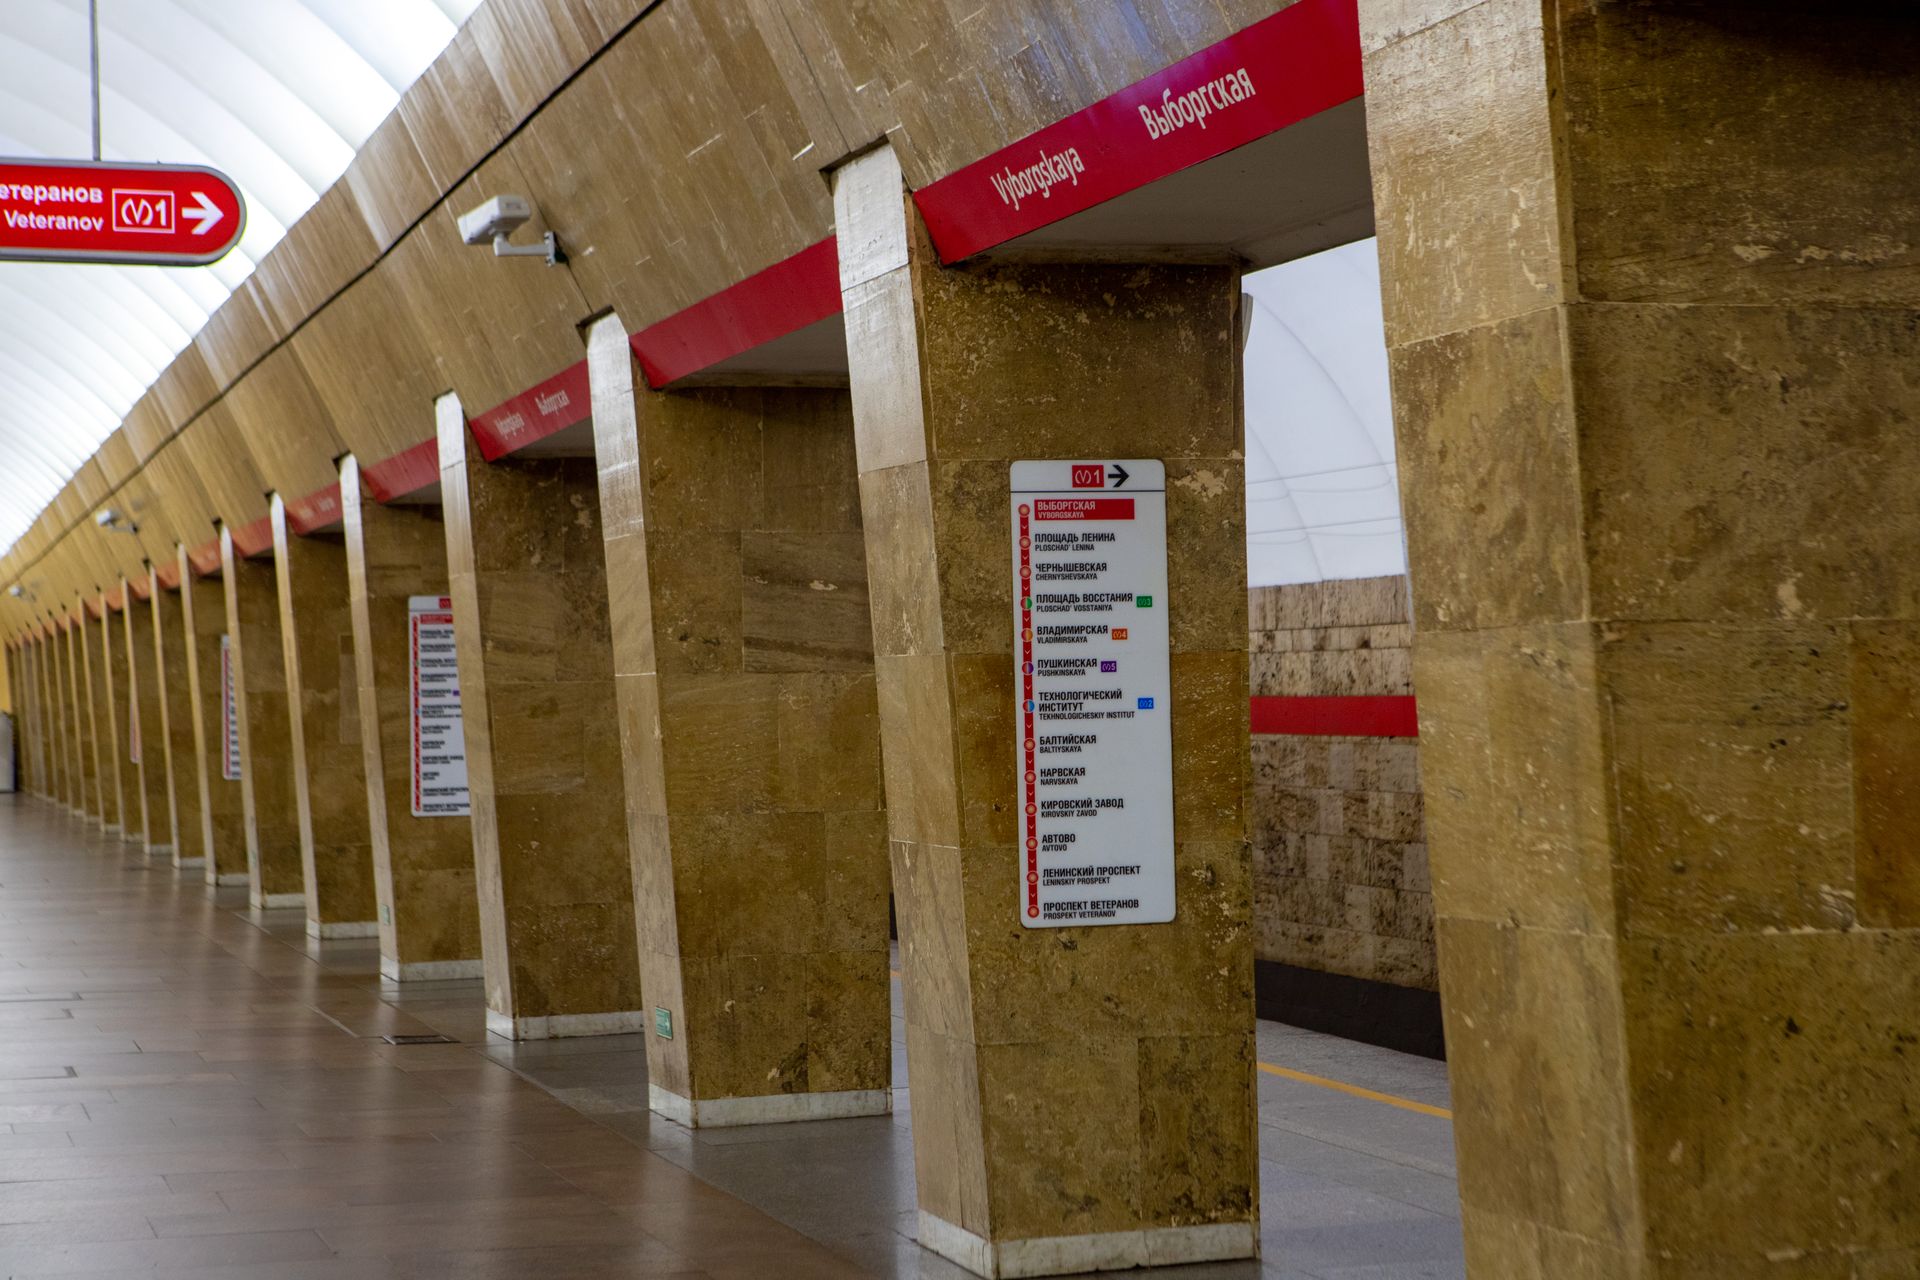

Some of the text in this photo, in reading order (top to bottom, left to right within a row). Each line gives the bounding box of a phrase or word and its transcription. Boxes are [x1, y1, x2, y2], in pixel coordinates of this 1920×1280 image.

[1138, 68, 1256, 140] Выборгская
[990, 147, 1085, 211] Vyborgskaya
[4, 209, 104, 231] Veteranov
[1038, 501, 1096, 510] ВЫБОРГСКАЯ
[1035, 533, 1115, 543] ПЛОЩАДЬ ЛЕНИНА
[1036, 563, 1107, 573] ЧЕРНЫШЕВСКАЯ
[1036, 573, 1097, 581] CHERNYSHEVSKAYA
[1036, 593, 1133, 604] ПЛОЩАДЬ ВОССТАНИЯ
[1075, 604, 1112, 612] VOSSTANIYA
[1037, 625, 1108, 636] ВЛАДИМИРСКАЯ
[1038, 659, 1097, 668] ПУШКИНСКАЯ
[1038, 669, 1085, 677] PUSHKINSKAYA
[1039, 689, 1122, 701] ТЕХНОЛОГИЧЕСКИЙ
[1039, 702, 1083, 712] ИНСТИТУТ
[1040, 711, 1134, 720] TEKHNOLOGICHESKIY INSTITUT
[1040, 734, 1096, 745] БАЛТИЙСКАЯ
[1041, 768, 1085, 777] НАРВСКАЯ
[1041, 778, 1078, 786] NARVSKAYA
[1041, 798, 1123, 809] КИРОВСКИЙ ЗАВОД
[1042, 809, 1097, 818] KIROVSKIY ZAVOD
[1042, 834, 1075, 844] АВТОВО
[1043, 866, 1141, 878] ЛЕНИНСКИЙ ПРОСПЕКТ
[1043, 877, 1110, 886] LENINSKIY PROSPEKT
[1044, 899, 1138, 911] ПРОСПЕКТ ВЕТЕРАНОВ
[1044, 912, 1077, 920] PROSPEKT
